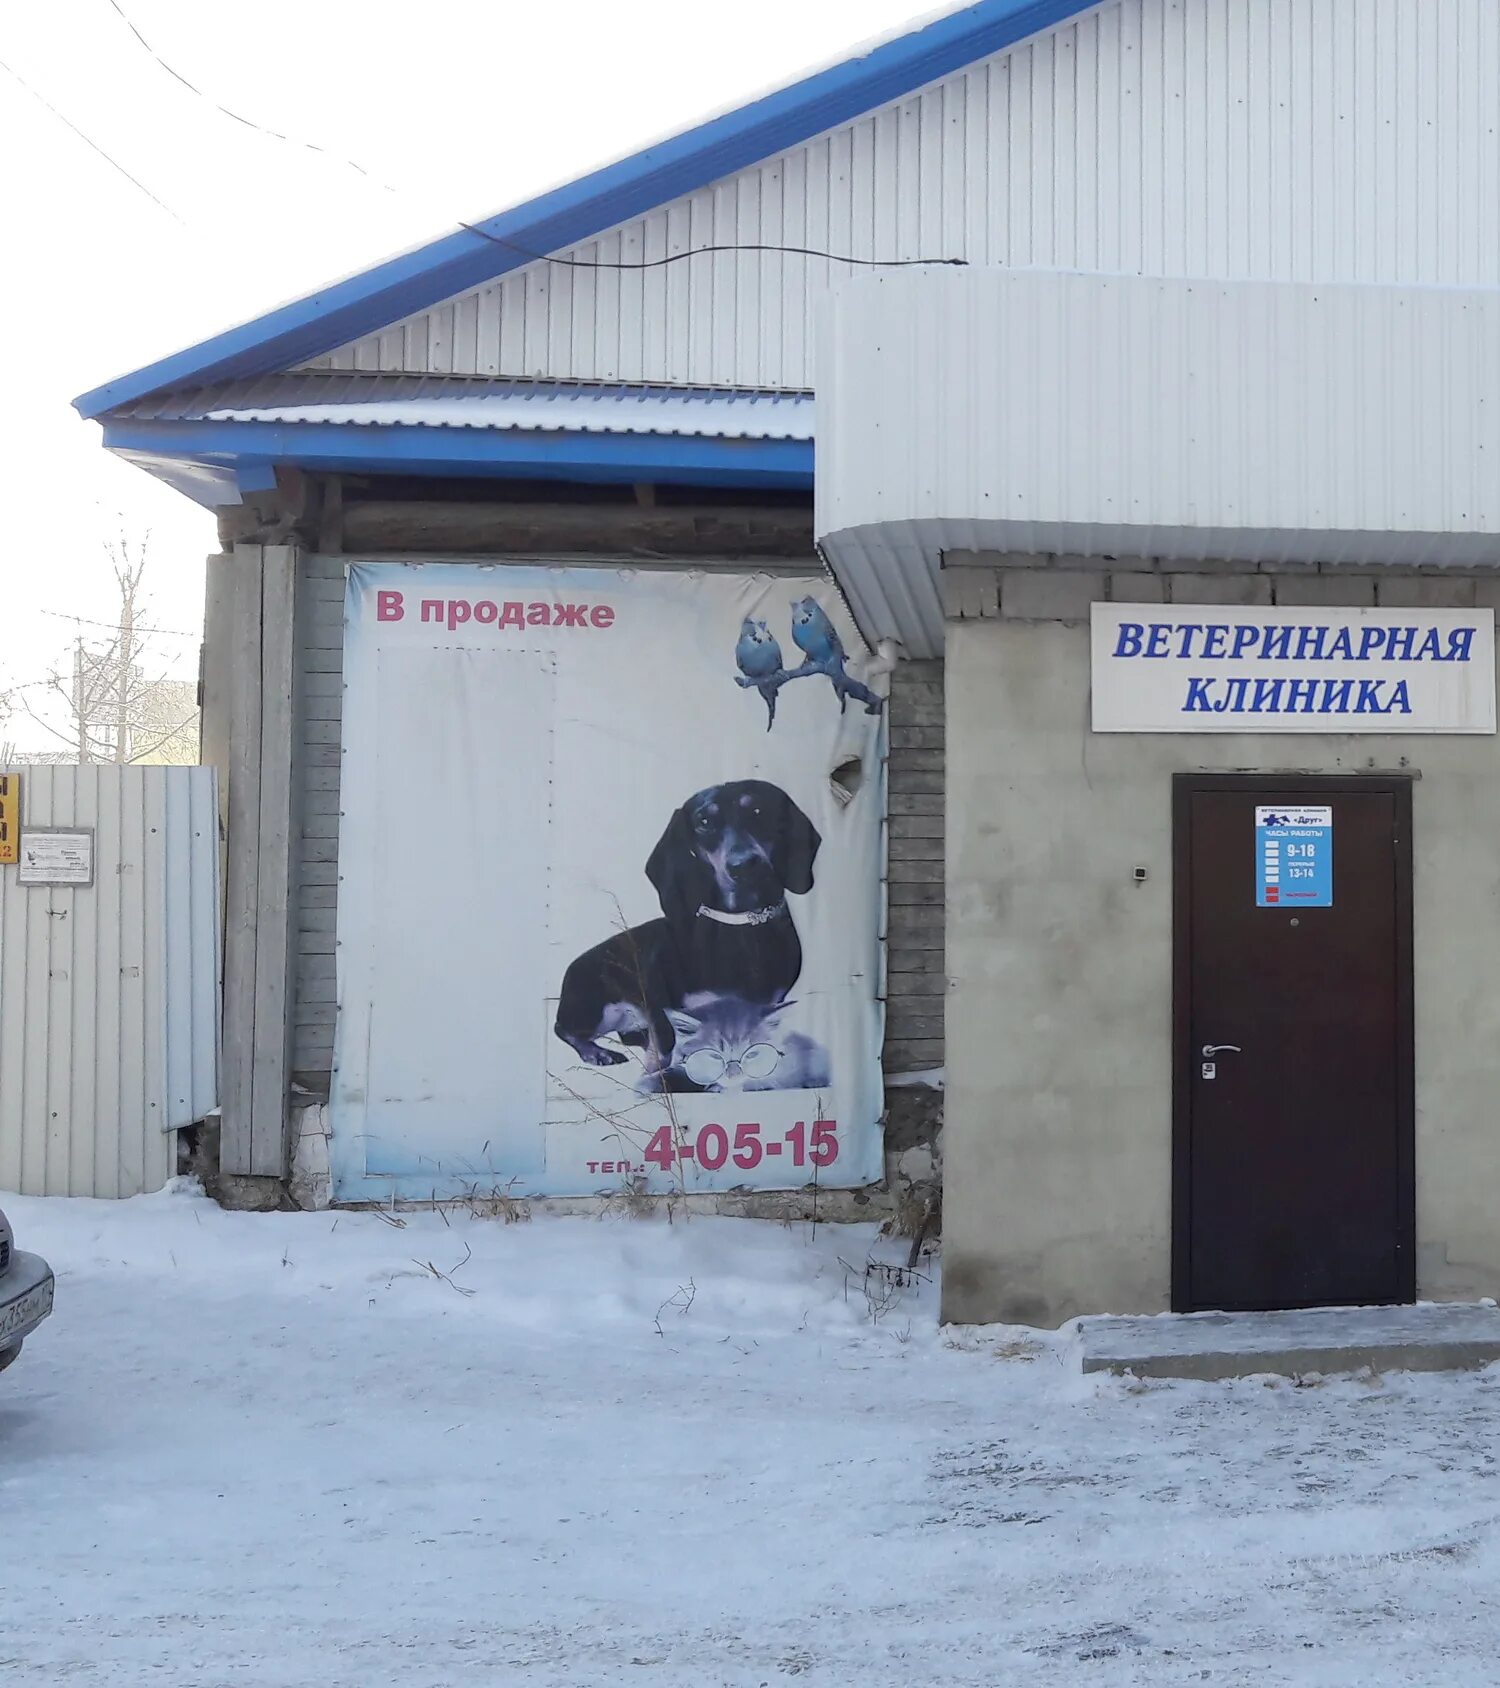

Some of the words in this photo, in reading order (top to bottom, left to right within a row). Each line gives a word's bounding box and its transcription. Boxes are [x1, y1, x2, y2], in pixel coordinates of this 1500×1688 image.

[376, 590, 405, 622] В
[420, 599, 616, 631] продаже
[1112, 623, 1477, 662] ВЕТЕРИНАРНАЯ
[1181, 677, 1413, 714] КЛИНИКА
[1287, 844, 1315, 857] 9-18
[1288, 868, 1314, 878] 13-14
[644, 1120, 839, 1171] 4-05-15
